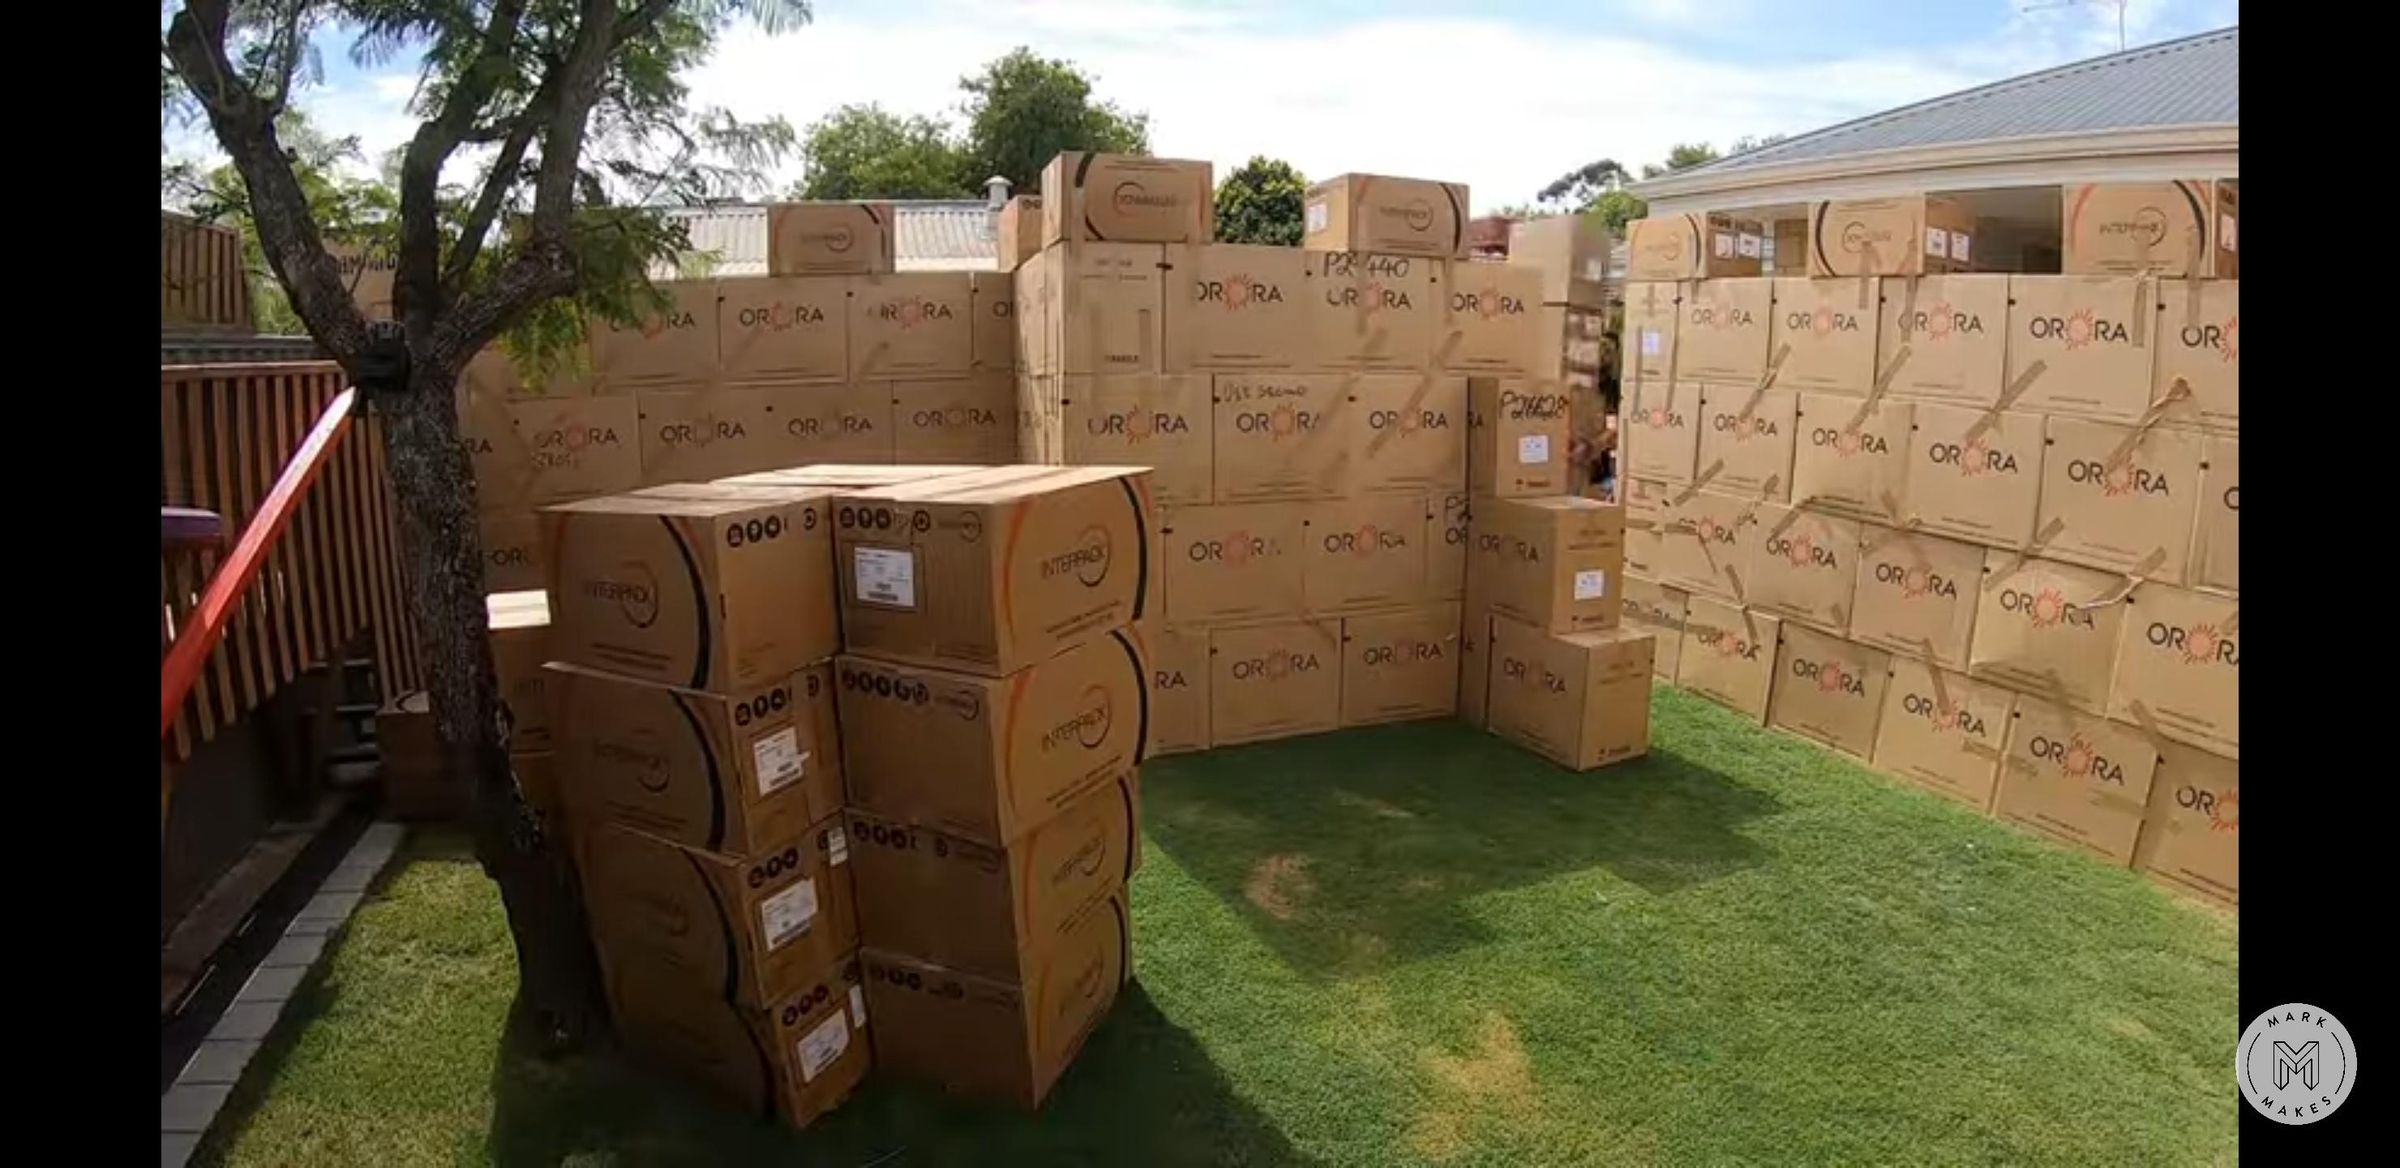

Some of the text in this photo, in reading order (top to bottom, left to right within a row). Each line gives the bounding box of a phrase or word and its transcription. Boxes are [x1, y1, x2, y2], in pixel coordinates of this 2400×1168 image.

[739, 301, 824, 331] ORORA
[1451, 288, 1525, 318] ORORA
[1692, 303, 1753, 328] ORORA
[1788, 308, 1859, 335] ORORA
[2030, 309, 2128, 348] ORORA
[659, 415, 746, 446] ORORA
[788, 414, 873, 435] ORORA
[912, 406, 997, 430] ORORA
[1088, 406, 1188, 440] ORORA
[1713, 413, 1778, 440] ORORA
[1812, 427, 1889, 457] ORORA
[1930, 441, 2019, 476] ORORA
[2067, 458, 2170, 498] ORORA
[1766, 535, 1838, 569] ORORA
[1875, 562, 1958, 599] ORORA
[1999, 587, 2095, 630] ORORA
[1232, 651, 1320, 681] ORORA
[1363, 642, 1443, 666] ORORA
[1793, 658, 1865, 698] ORORA
[1903, 693, 1986, 739] ORORA
[2029, 734, 2125, 786] ORORA
